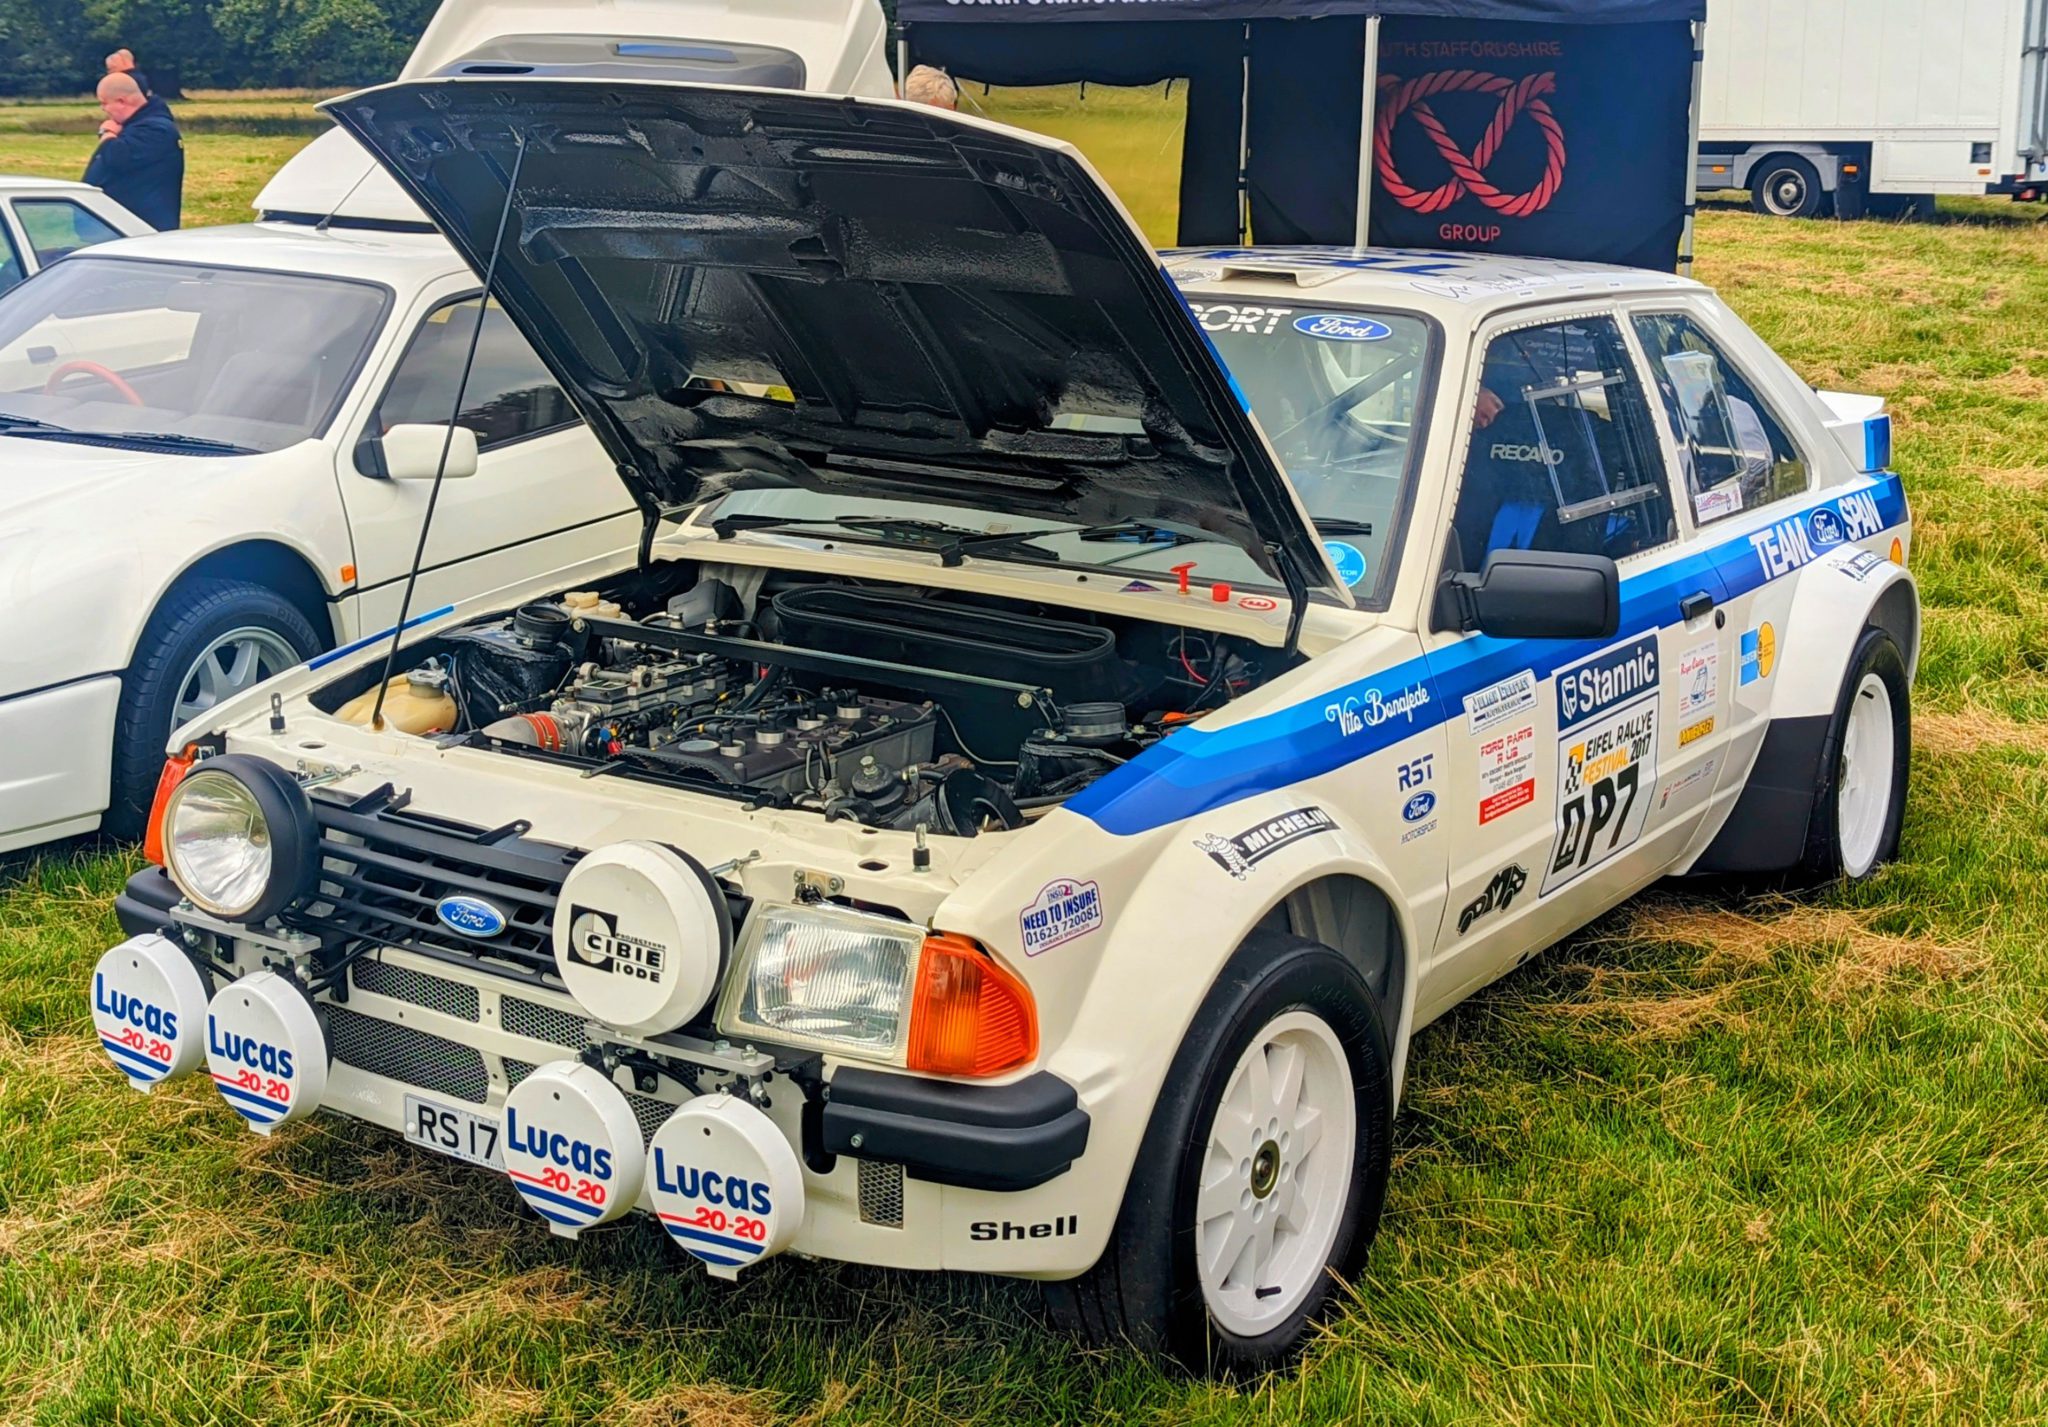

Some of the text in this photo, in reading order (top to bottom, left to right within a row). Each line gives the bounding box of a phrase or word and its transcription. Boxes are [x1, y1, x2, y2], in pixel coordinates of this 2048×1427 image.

[1420, 40, 1564, 58] STAFFORDSHIRE
[1439, 223, 1501, 242] GROUP
[1307, 316, 1376, 339] Ford
[1749, 489, 1884, 581] TEAM Ford SPAN
[1579, 646, 1655, 713] Stannic
[1325, 696, 1363, 737] Vito
[1364, 681, 1431, 727] Bonafede
[1480, 726, 1532, 757] FORD PARTS
[1586, 730, 1613, 761] EIFEL
[1616, 709, 1654, 746] RALLYE
[1583, 746, 1629, 788] FESTIVAL
[1630, 732, 1652, 764] 2017
[1407, 794, 1431, 821] Ford
[1242, 806, 1330, 853] MICHELIN
[1023, 888, 1097, 931] NEED TO INSURE
[1025, 903, 1099, 947] 01623 720081
[586, 933, 661, 968] CIBIE
[615, 961, 660, 983] IODE
[96, 972, 178, 1040] Lucas
[121, 1027, 173, 1062] 20-20
[208, 1013, 293, 1079] Lucas
[237, 1068, 290, 1102] 20-20
[417, 1103, 459, 1149] RS
[469, 1120, 498, 1160] 17
[507, 1106, 612, 1181] Lucas
[540, 1167, 606, 1205] 20-20
[654, 1146, 773, 1216] Lucas
[695, 1206, 766, 1242] 20-20
[970, 1215, 1078, 1241] Shell
